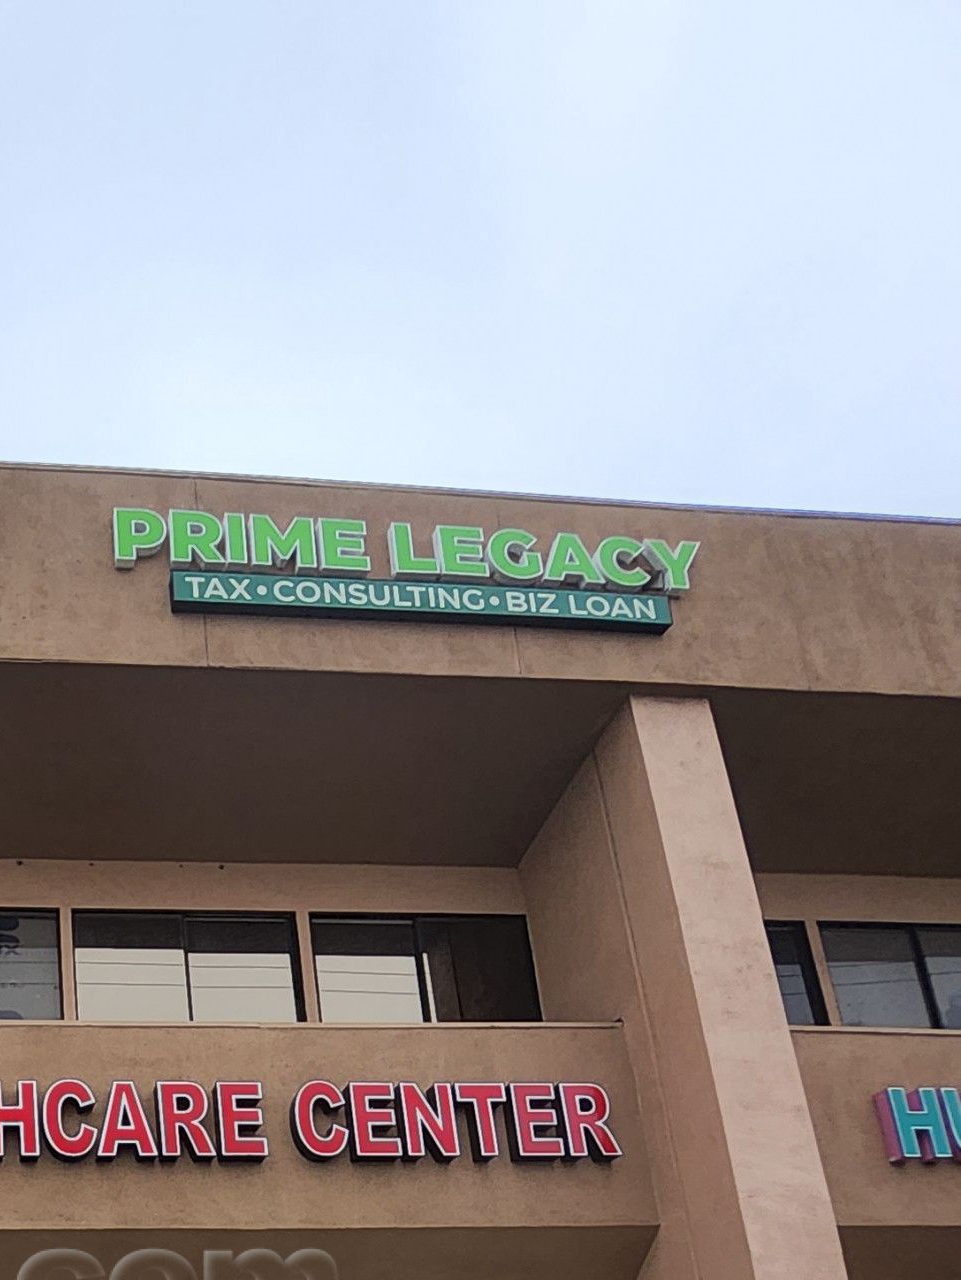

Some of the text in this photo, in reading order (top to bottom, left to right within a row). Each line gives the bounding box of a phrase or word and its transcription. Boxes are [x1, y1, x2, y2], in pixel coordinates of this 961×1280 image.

[113, 508, 699, 590] PRIME LEGACY
[184, 576, 656, 620] TAX CONSULTING BIZ LOAN
[292, 1080, 622, 1160] CENTER
